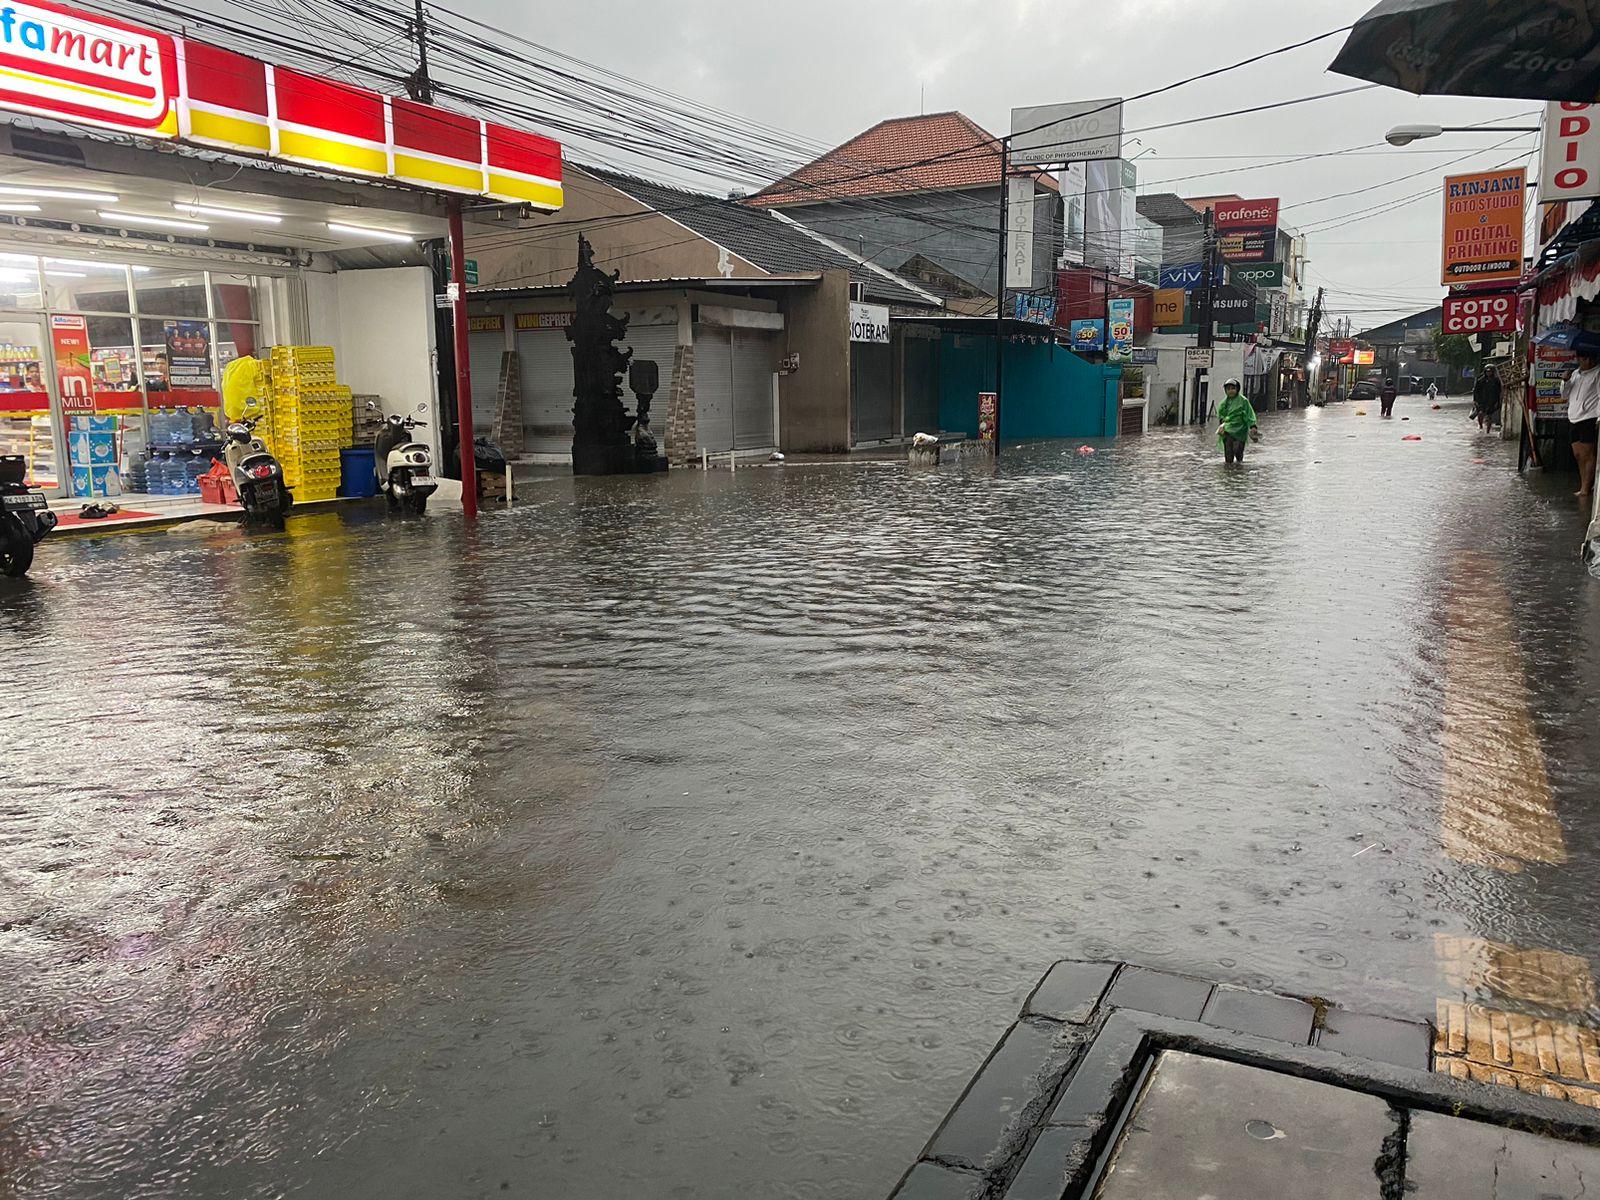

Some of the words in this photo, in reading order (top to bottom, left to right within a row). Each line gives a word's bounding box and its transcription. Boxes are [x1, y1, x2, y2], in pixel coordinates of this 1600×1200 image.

[1054, 149, 1104, 159] PHYSIOTHERAPY
[1449, 176, 1521, 197] RINJANI
[1449, 198, 1476, 215] FOTO
[1478, 194, 1520, 210] STUDIO
[1218, 207, 1269, 220] erafone
[1479, 215, 1488, 224] &
[1455, 224, 1512, 243] DIGITAL
[1448, 239, 1519, 260] PRINTING
[1454, 263, 1481, 273] OUTDOOR
[1486, 261, 1510, 271] INDOOR
[1237, 270, 1275, 280] oppo
[1450, 298, 1508, 315] FOTO
[1448, 313, 1510, 331] COPY
[1114, 327, 1128, 336] 50
[61, 397, 93, 408] MILD
